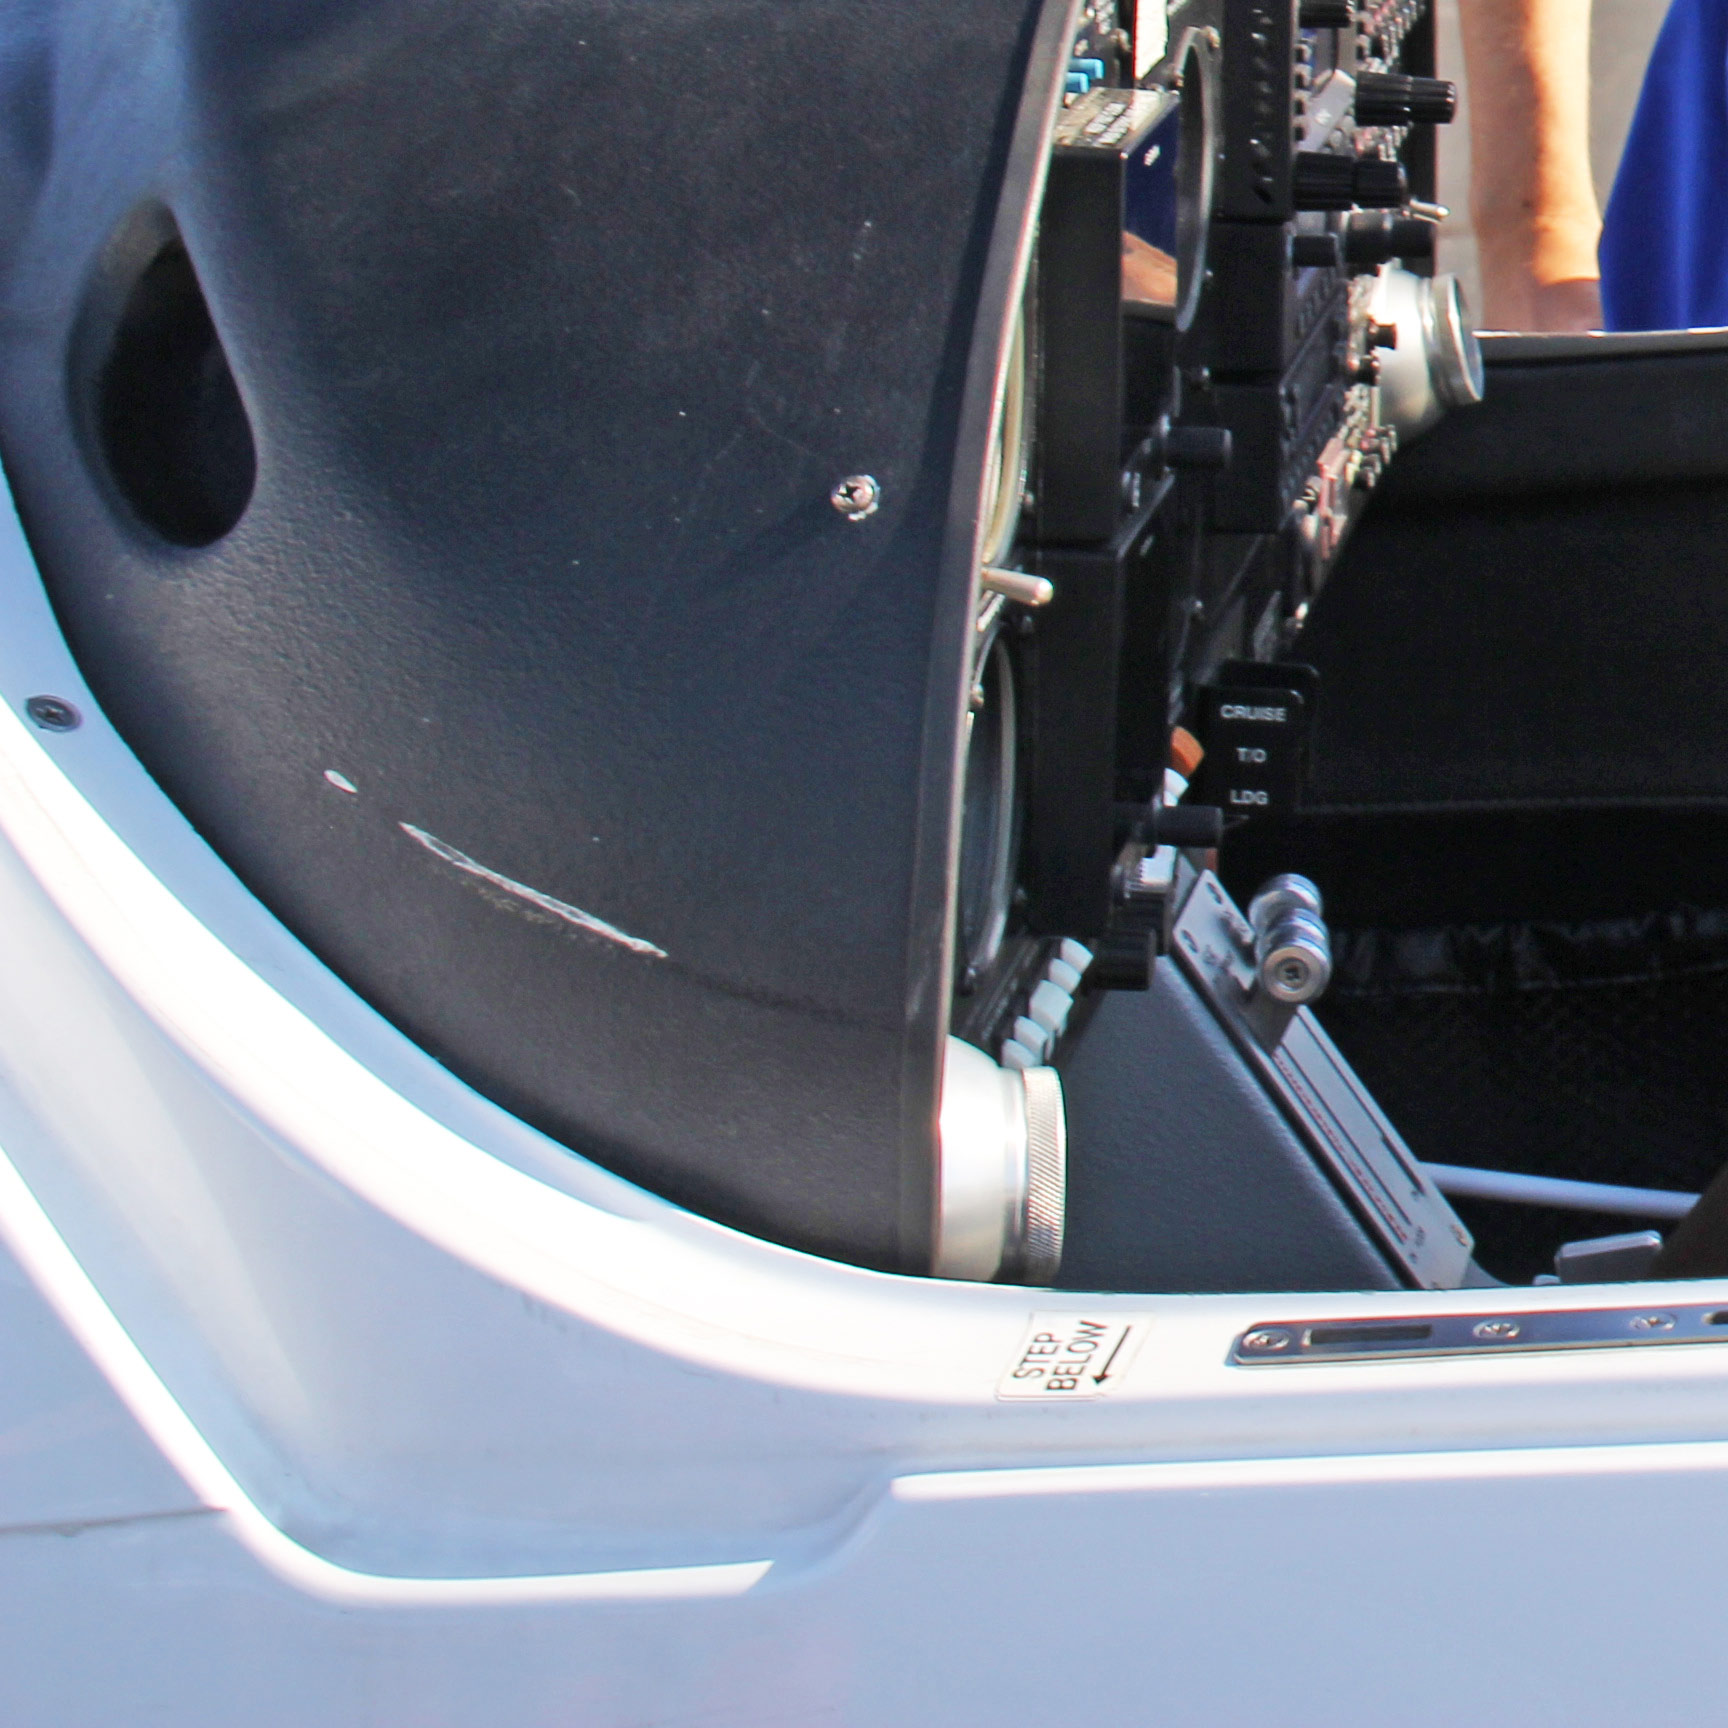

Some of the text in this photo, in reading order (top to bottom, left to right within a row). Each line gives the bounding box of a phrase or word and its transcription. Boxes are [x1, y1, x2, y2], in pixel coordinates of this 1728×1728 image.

[1220, 704, 1288, 722] CRUISE
[1230, 789, 1269, 805] LDG
[1012, 1331, 1063, 1379] STEP
[1045, 1319, 1109, 1391] BELOW
